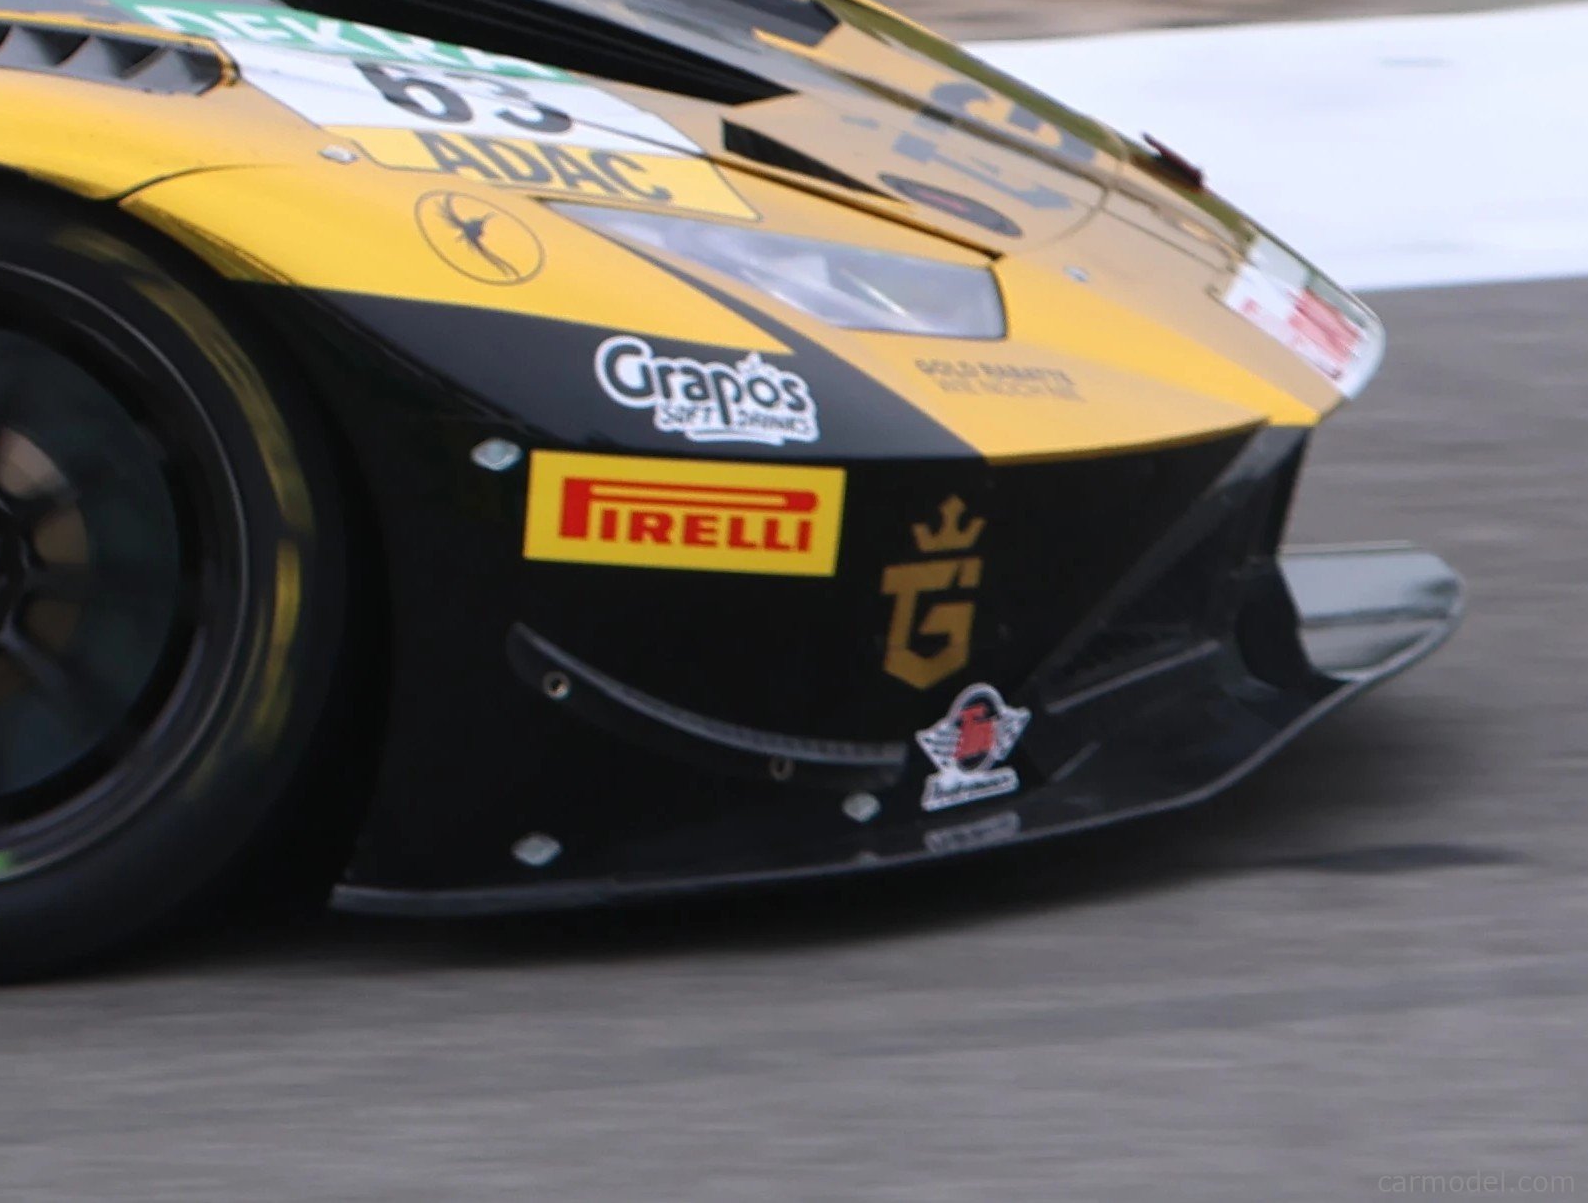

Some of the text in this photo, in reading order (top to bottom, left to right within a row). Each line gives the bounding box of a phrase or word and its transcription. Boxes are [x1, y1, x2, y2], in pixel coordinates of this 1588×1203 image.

[354, 61, 573, 134] 63
[413, 131, 673, 203] ADAC
[560, 474, 819, 554] PIRELLI
